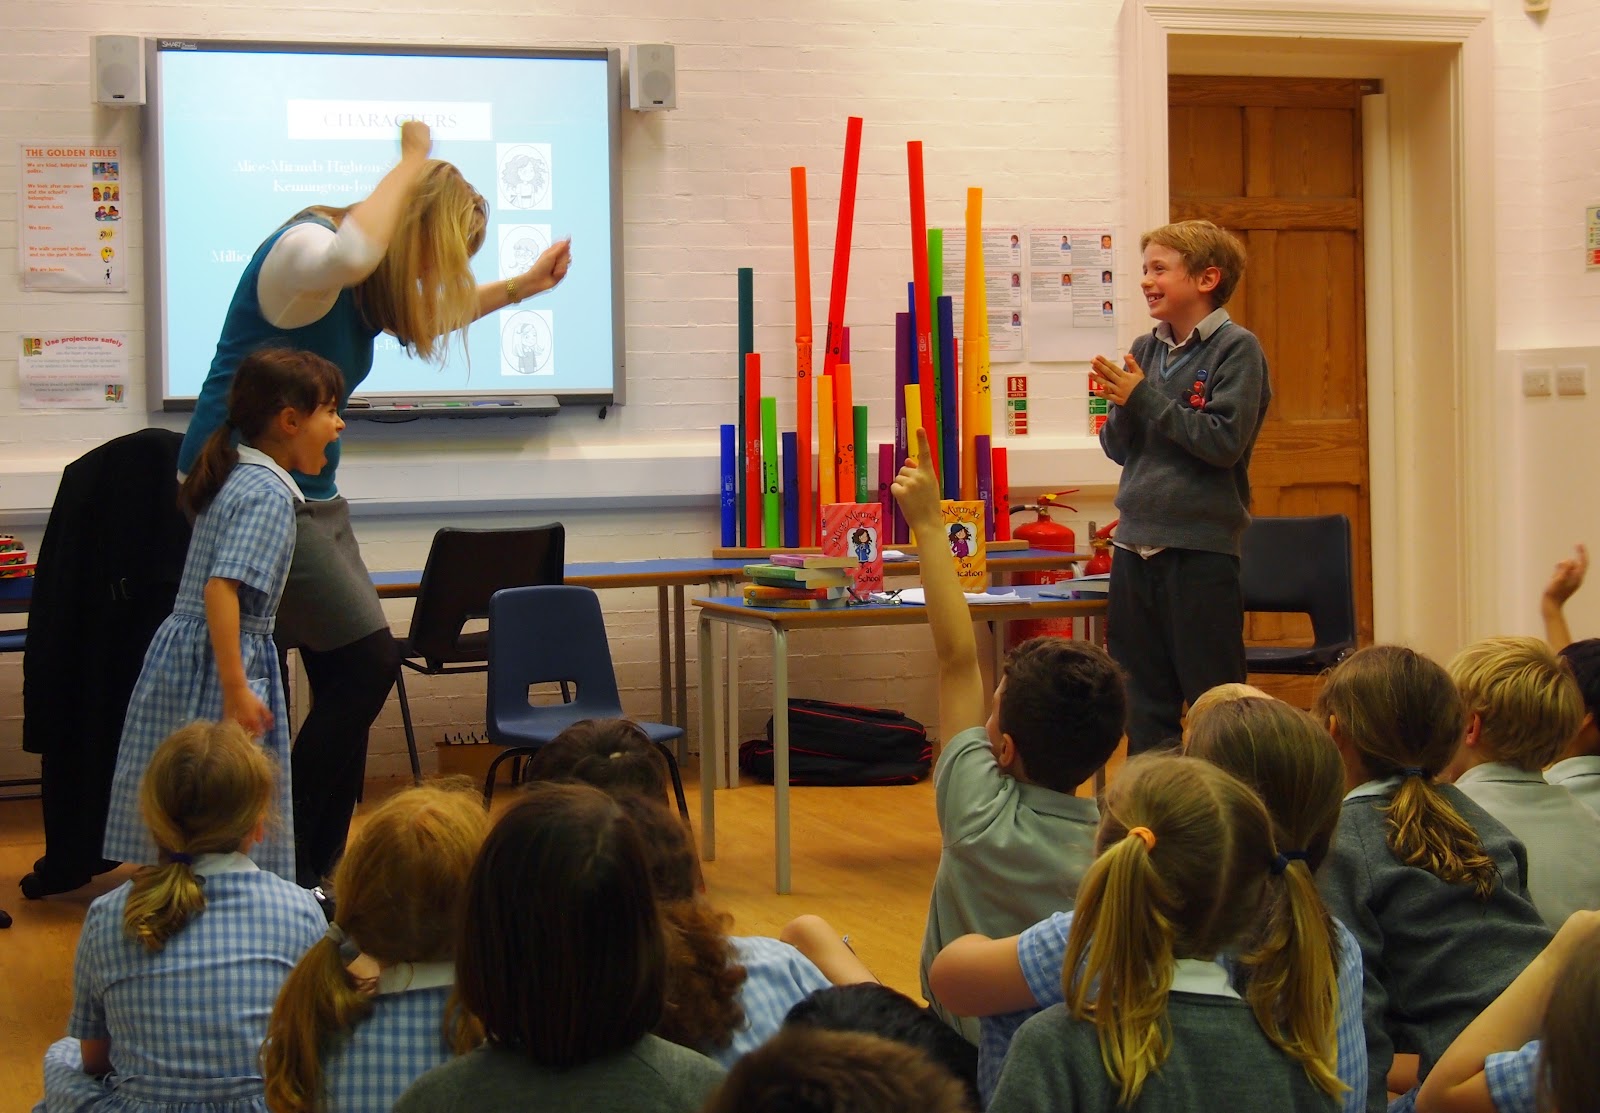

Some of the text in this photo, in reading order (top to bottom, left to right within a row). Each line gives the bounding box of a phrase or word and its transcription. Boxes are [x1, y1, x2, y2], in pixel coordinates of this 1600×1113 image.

[26, 149, 117, 157] THE GOLDEN RULES
[272, 179, 375, 195] Kennington-Jon
[211, 249, 252, 263] Millice
[45, 339, 60, 347] Use
[61, 335, 99, 344] projectors
[101, 337, 123, 348] safely
[941, 505, 981, 523] Miranda
[865, 566, 873, 574] at
[957, 570, 983, 578] cation
[857, 575, 881, 583] School
